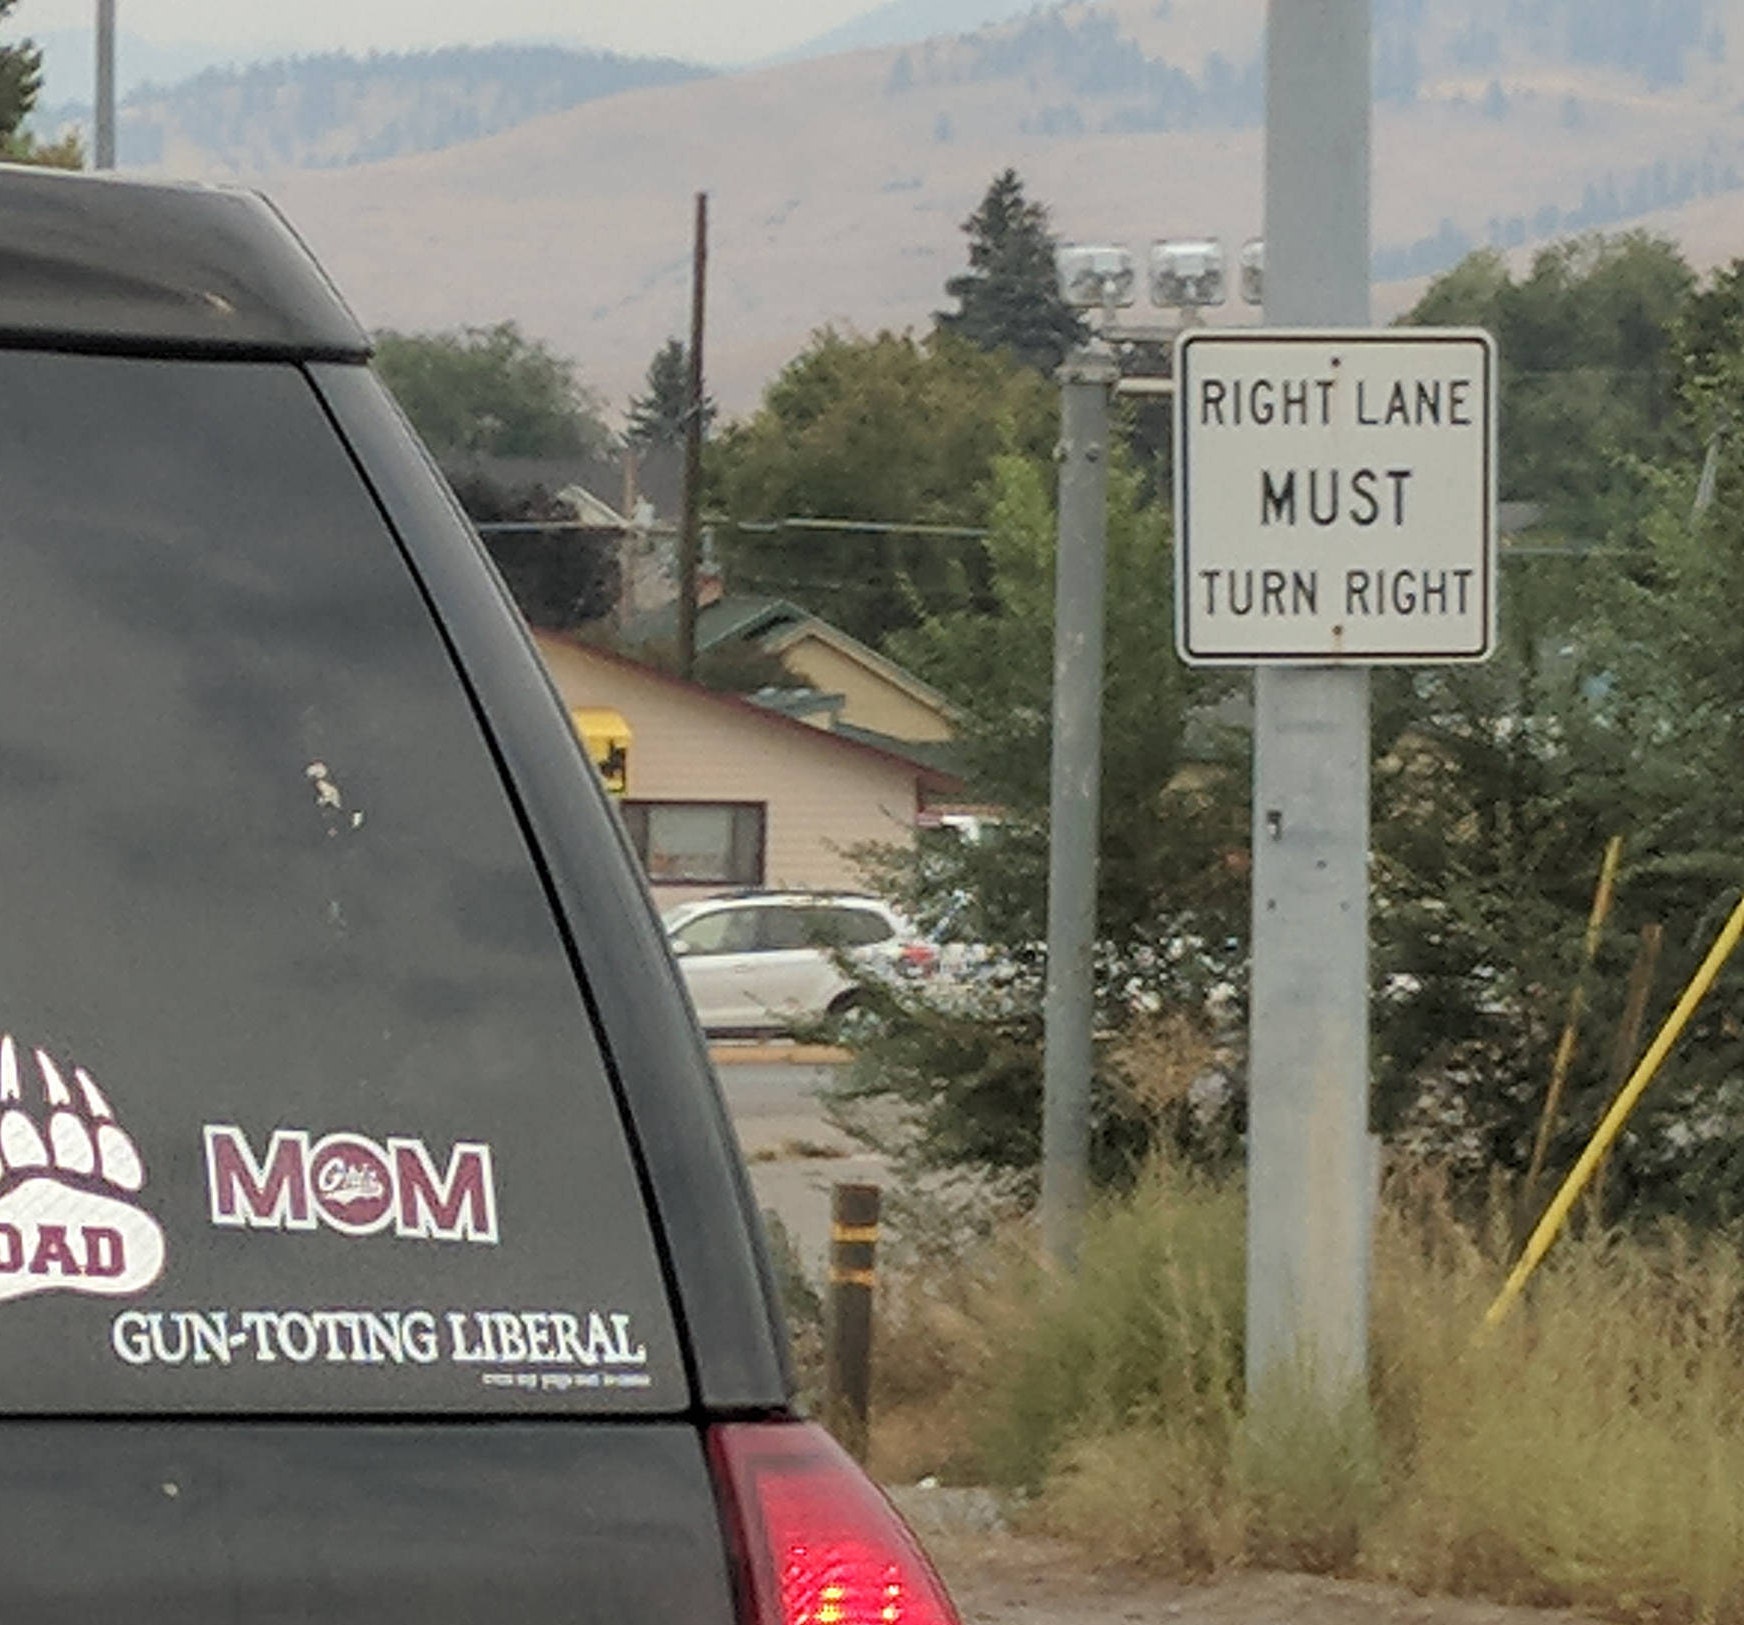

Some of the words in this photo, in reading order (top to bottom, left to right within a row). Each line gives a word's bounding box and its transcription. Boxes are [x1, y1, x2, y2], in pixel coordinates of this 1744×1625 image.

[1201, 379, 1334, 425] RIGHT
[1357, 380, 1473, 425] LANE
[1260, 469, 1412, 526] MUST
[1199, 570, 1318, 615] TURN
[1346, 570, 1473, 615] RIGHT
[203, 1124, 499, 1244] MOM
[113, 1310, 439, 1364] GUN-TOTING
[447, 1310, 647, 1365] LIBERAL
